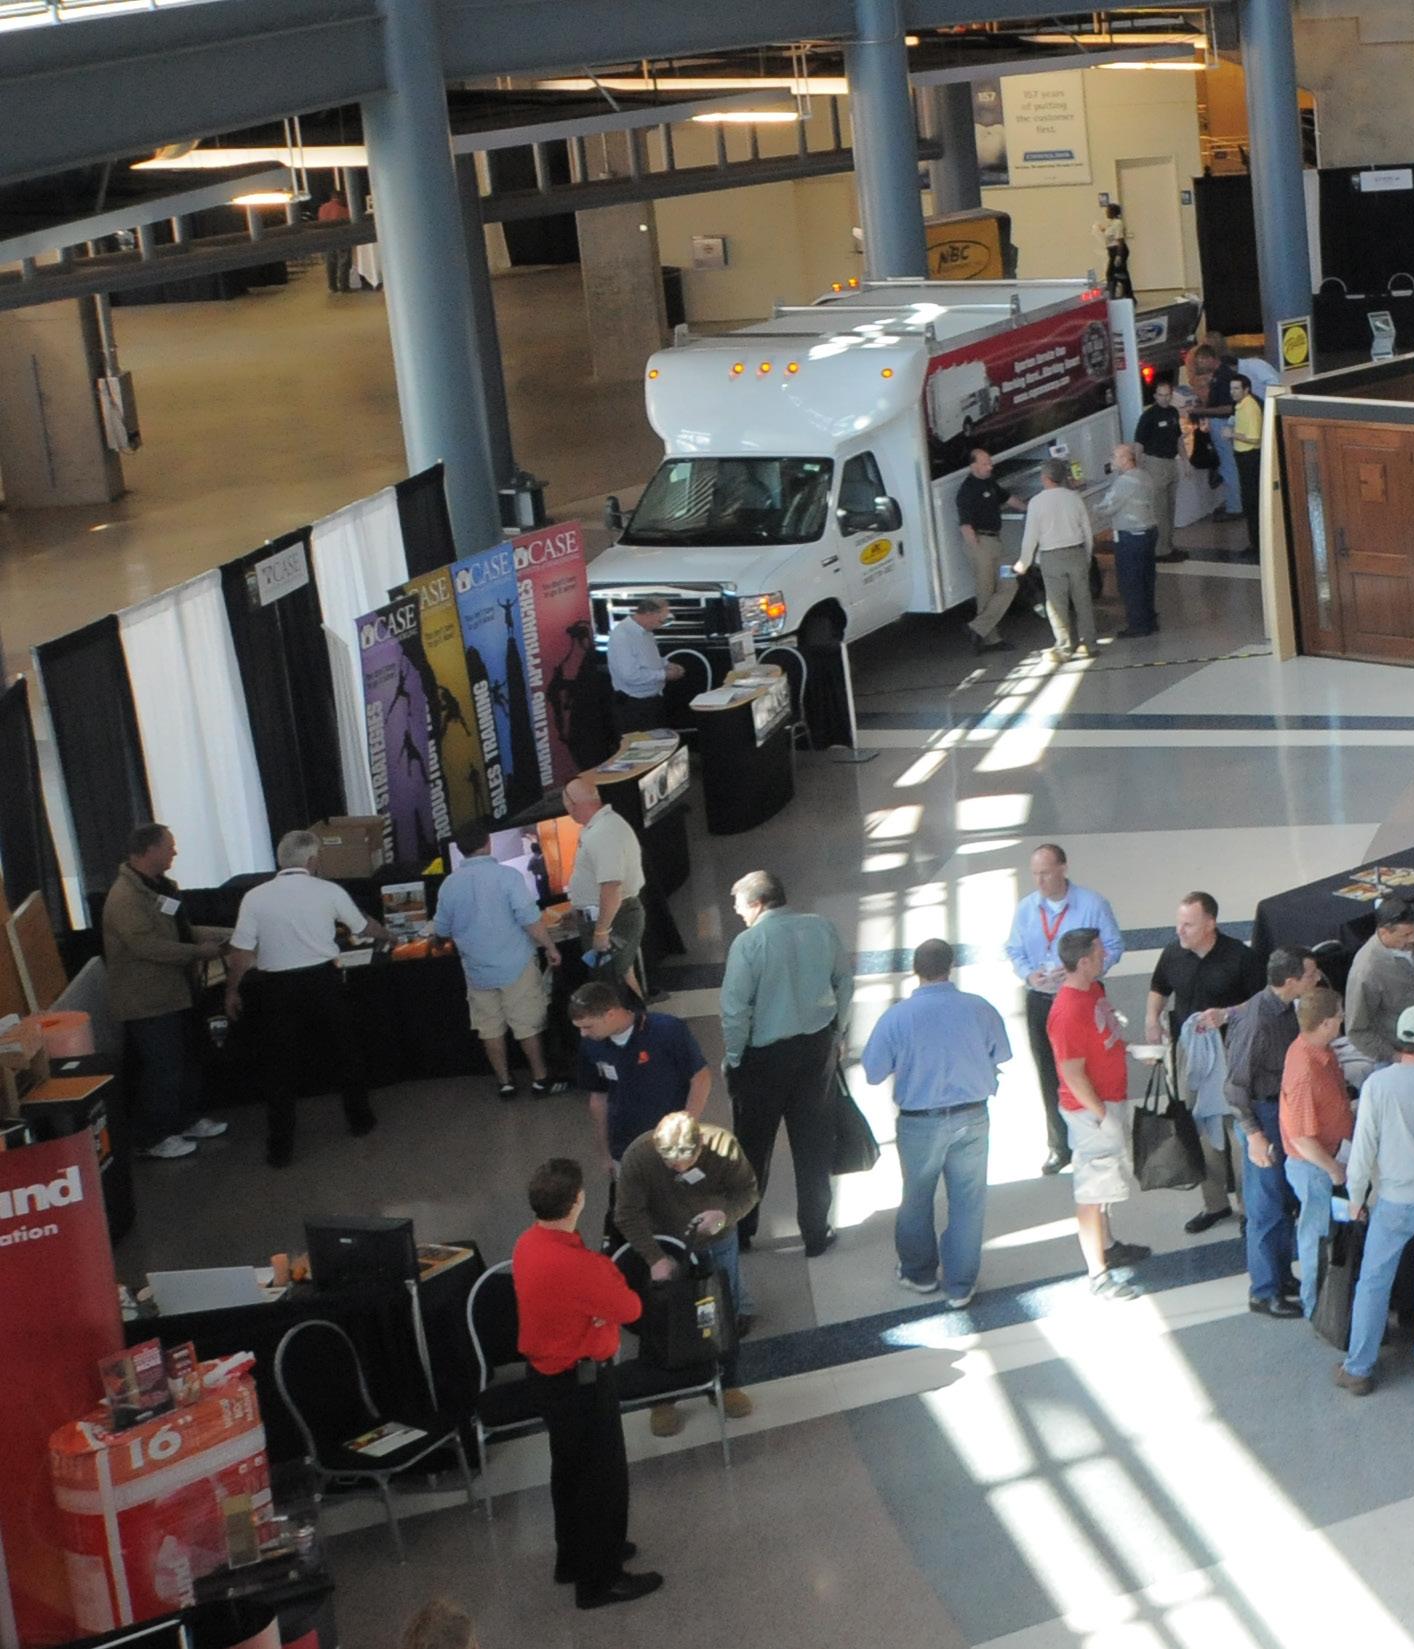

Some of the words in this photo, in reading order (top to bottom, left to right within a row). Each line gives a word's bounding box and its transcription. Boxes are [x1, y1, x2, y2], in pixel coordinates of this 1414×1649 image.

[470, 551, 511, 587] CASE
[528, 531, 579, 564] CASE
[373, 604, 418, 642] CASE
[473, 680, 498, 760] TRAINING
[532, 690, 554, 787] MARKETING
[367, 700, 391, 810] STRATEGIES
[428, 739, 451, 840] RODUCTION
[487, 764, 508, 819] SALES
